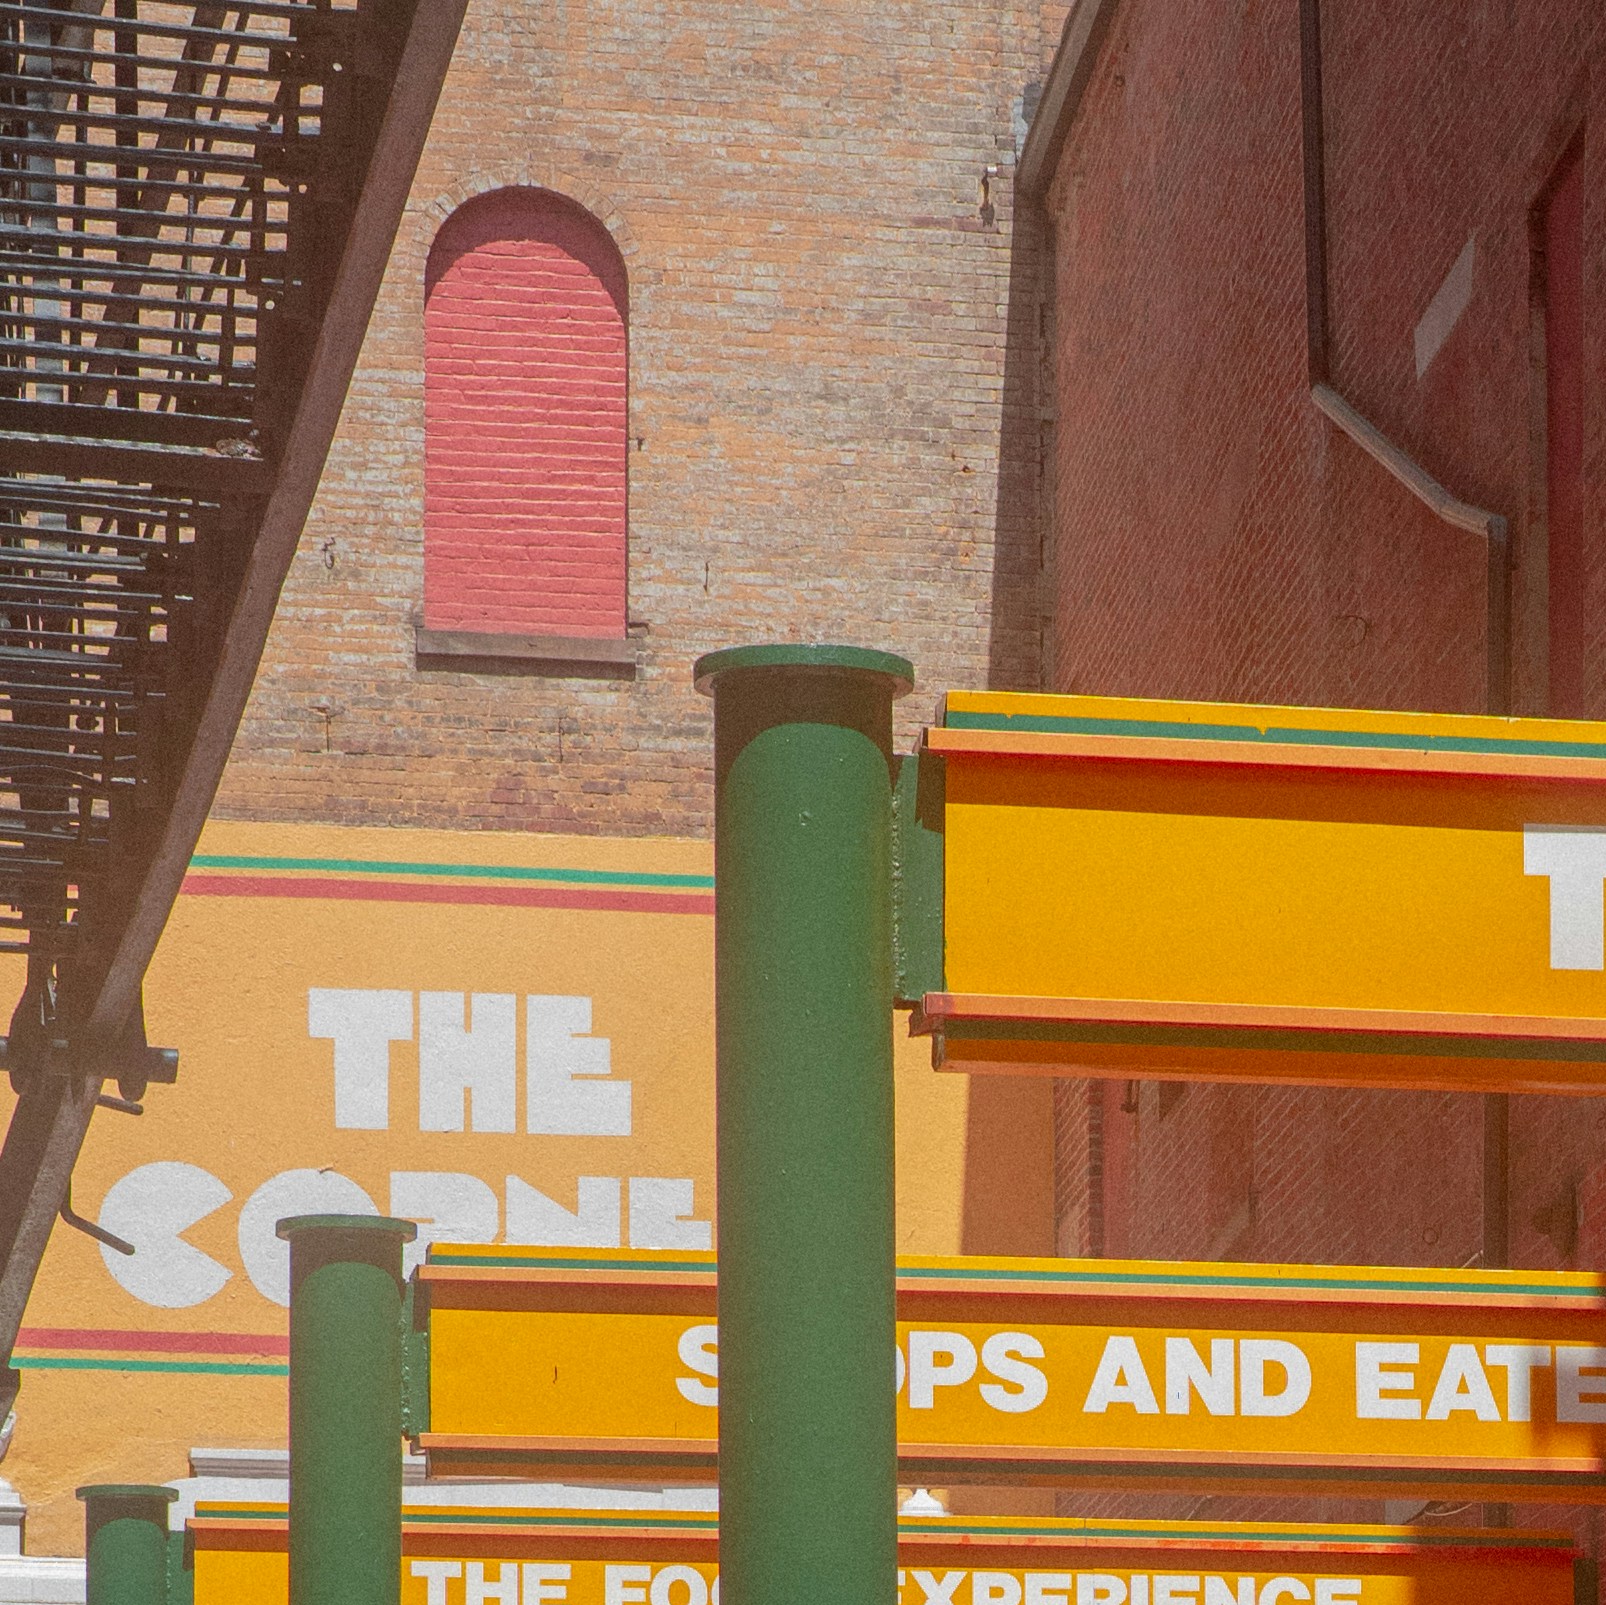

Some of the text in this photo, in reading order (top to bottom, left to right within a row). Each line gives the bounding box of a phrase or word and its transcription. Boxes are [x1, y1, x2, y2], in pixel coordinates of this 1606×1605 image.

[308, 986, 633, 1136] THE
[98, 1160, 714, 1309] CORNE
[675, 1324, 1049, 1414] SPS
[1083, 1335, 1313, 1418] AND
